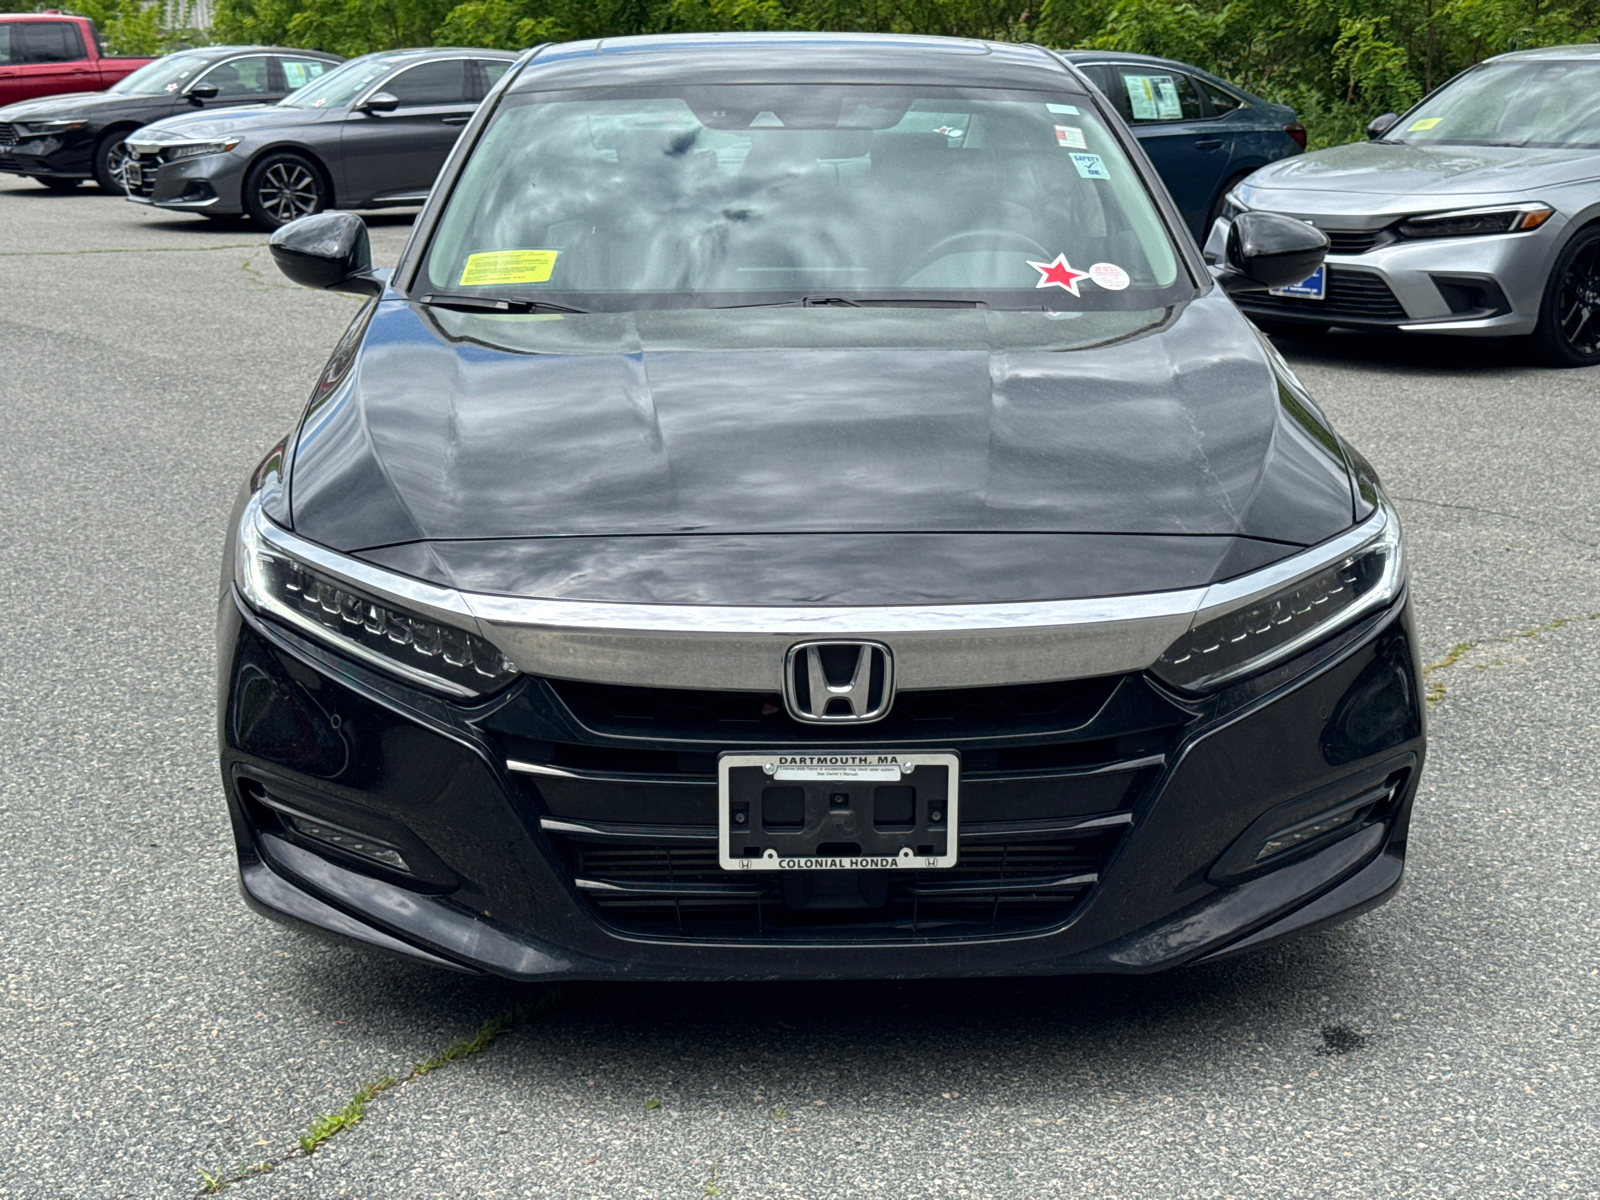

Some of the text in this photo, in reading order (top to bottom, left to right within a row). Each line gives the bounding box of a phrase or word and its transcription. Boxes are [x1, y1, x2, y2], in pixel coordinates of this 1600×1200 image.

[779, 756, 899, 765] DARTMOUTH, MA
[779, 858, 899, 869] COLONIAL HONDA
